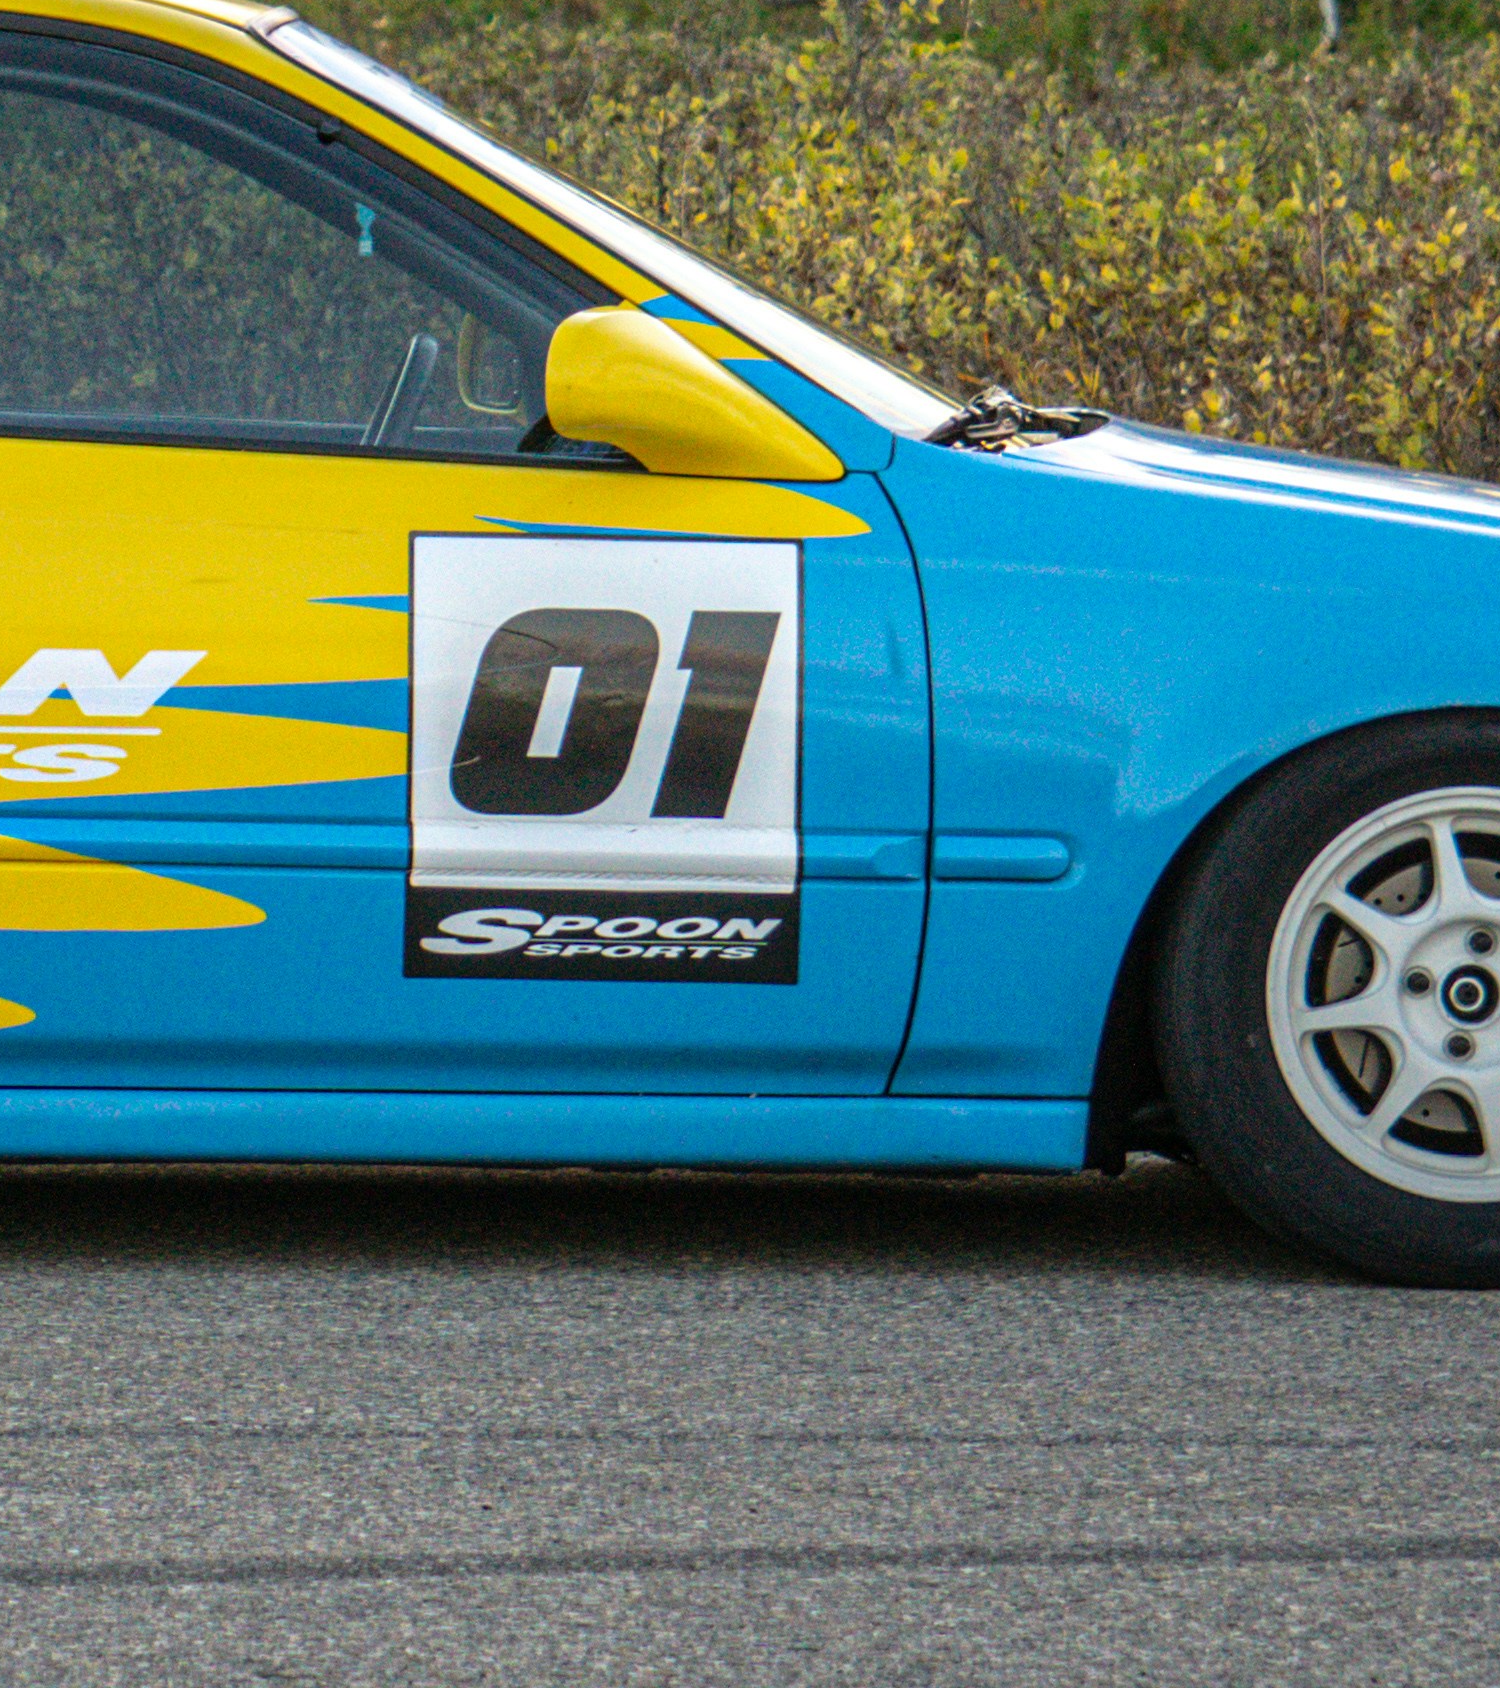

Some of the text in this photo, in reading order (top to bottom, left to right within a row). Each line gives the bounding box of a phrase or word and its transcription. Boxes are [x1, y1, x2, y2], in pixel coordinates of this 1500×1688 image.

[449, 608, 782, 819] 01
[420, 908, 782, 955] SPOON
[524, 943, 757, 960] SPORTS
